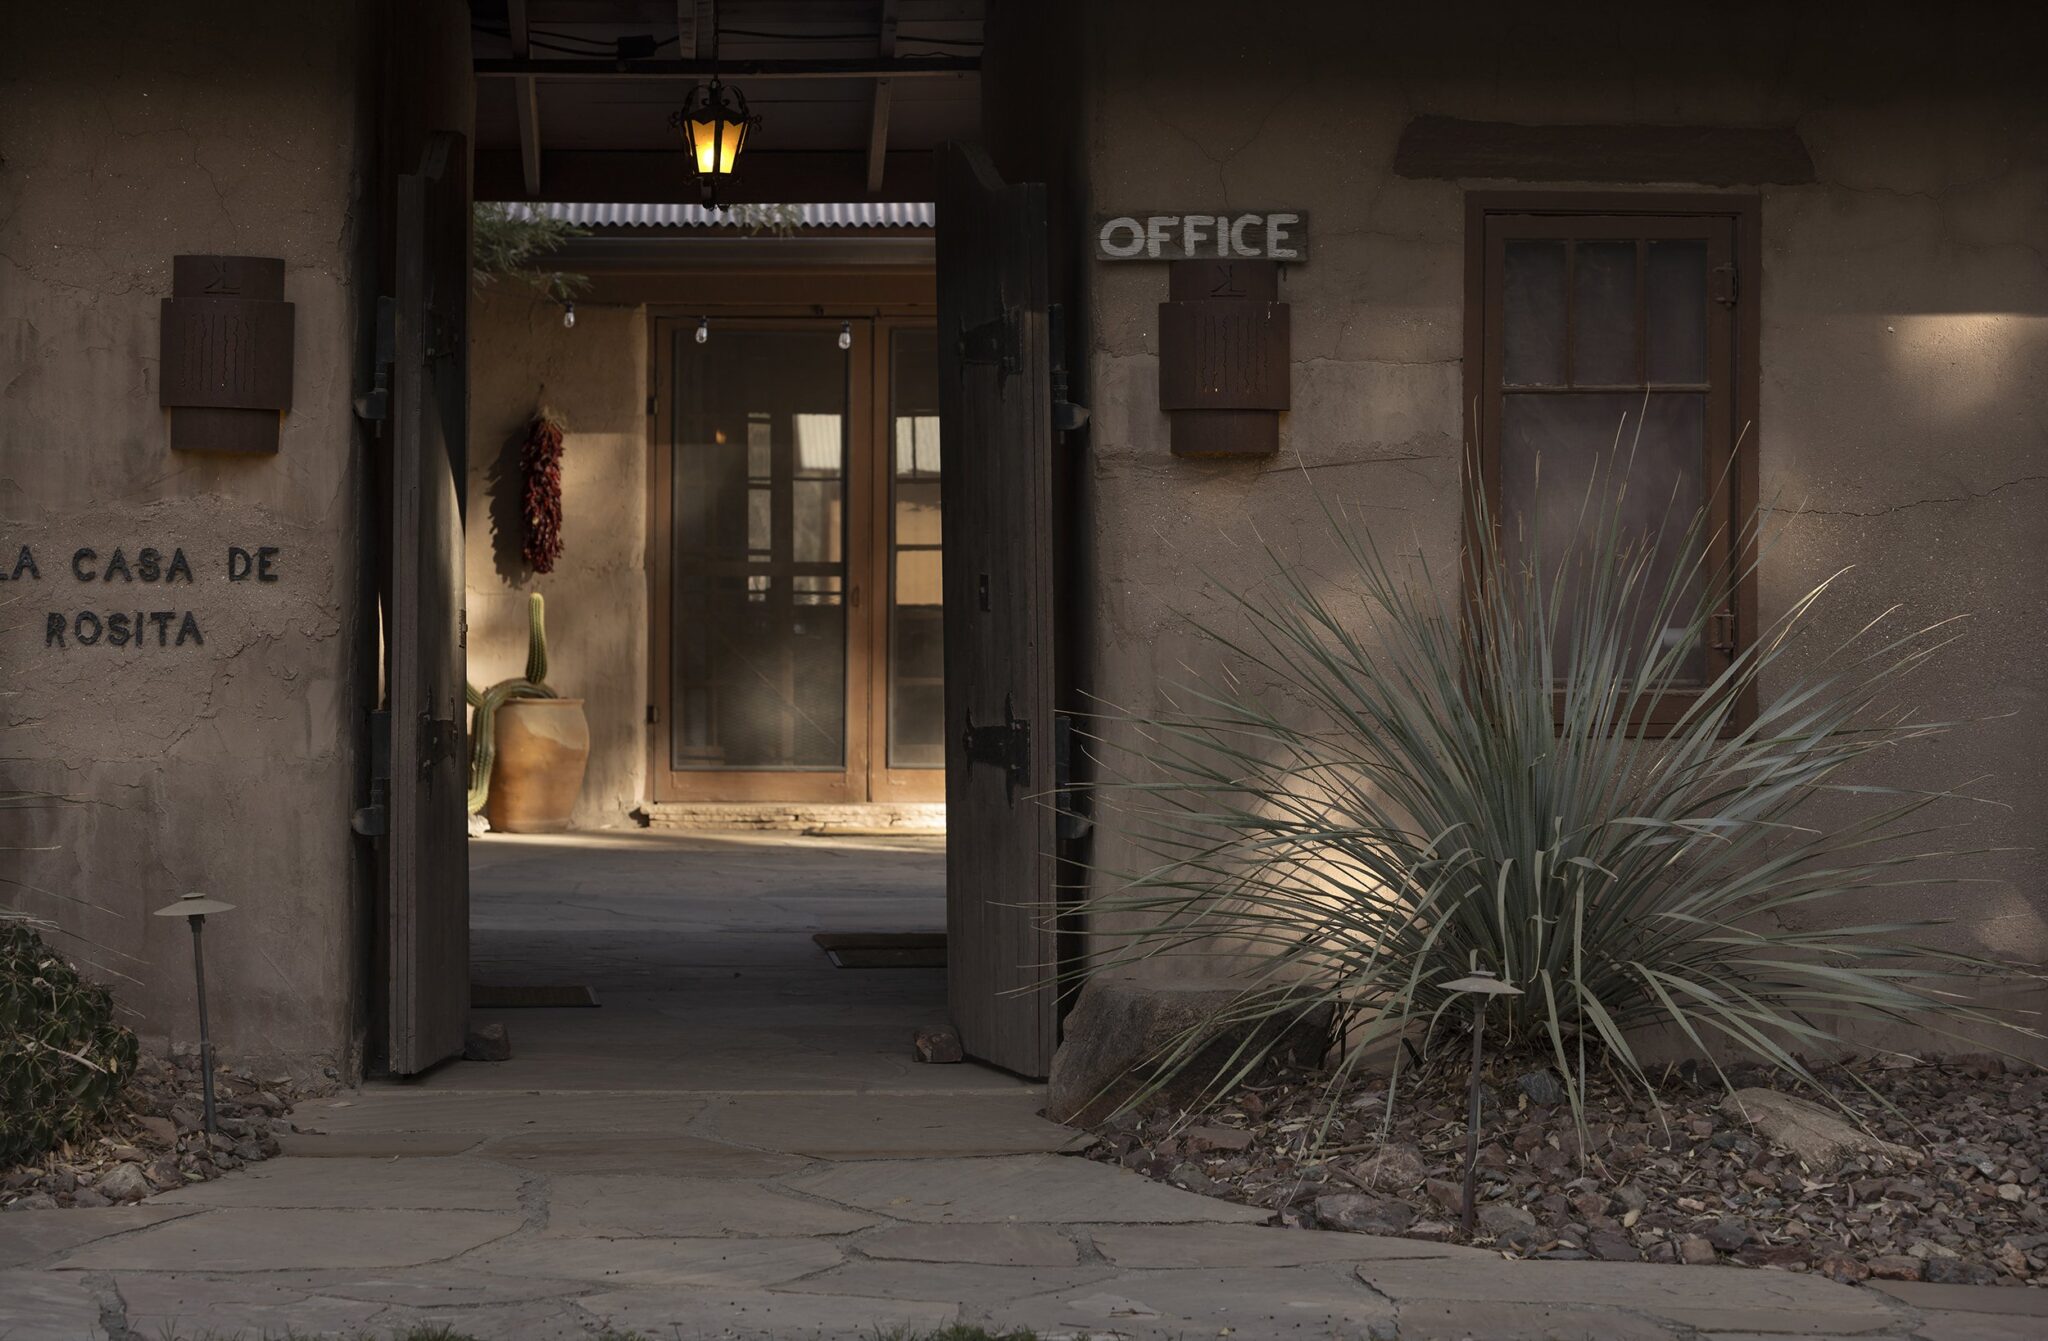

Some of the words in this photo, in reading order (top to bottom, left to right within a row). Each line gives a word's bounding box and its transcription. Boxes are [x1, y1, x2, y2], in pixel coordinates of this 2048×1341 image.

[1100, 213, 1299, 258] OFFICE
[72, 547, 194, 582] CASA
[228, 547, 280, 582] DE
[45, 610, 204, 648] ROSITA
